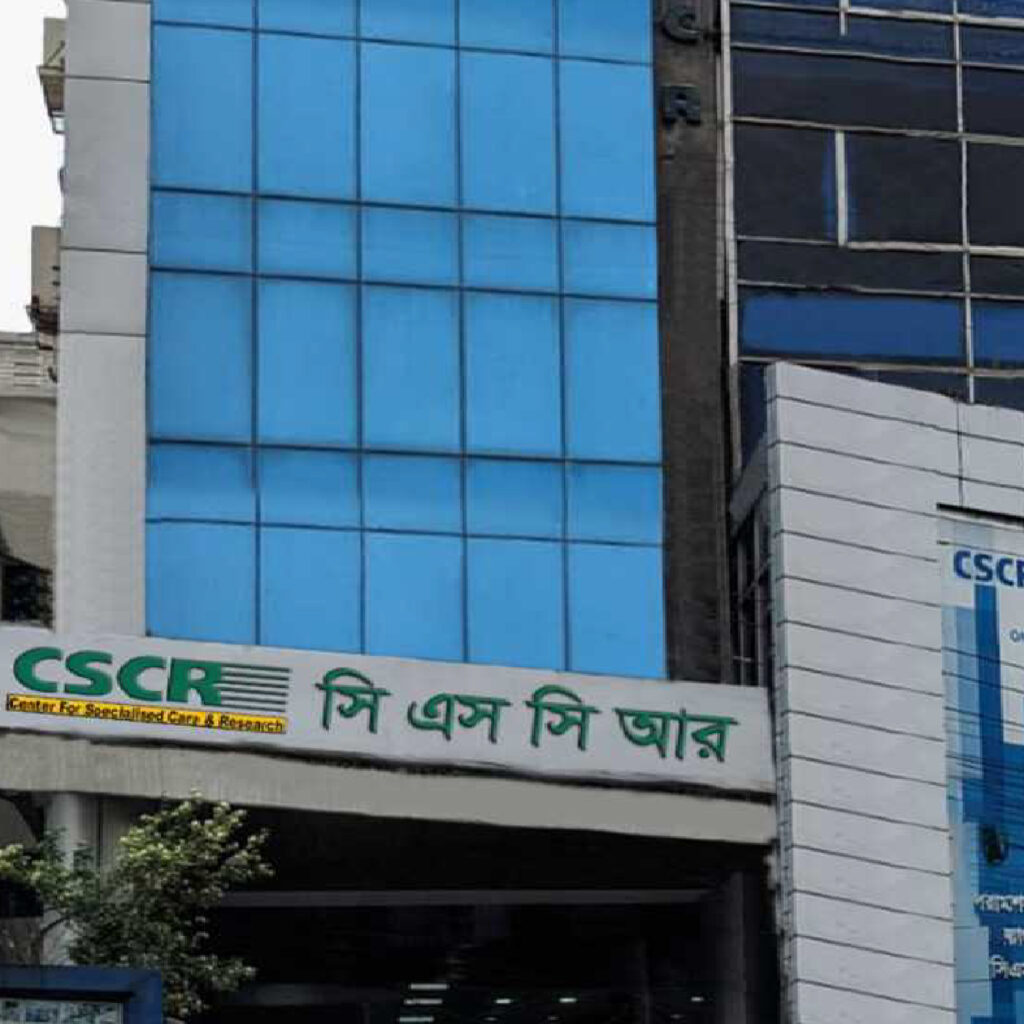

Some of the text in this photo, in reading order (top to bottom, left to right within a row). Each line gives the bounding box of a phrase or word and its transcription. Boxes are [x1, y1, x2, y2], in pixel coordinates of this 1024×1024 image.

[13, 646, 222, 707] CSCR
[9, 696, 56, 713] Center
[60, 700, 81, 714] For
[169, 710, 200, 726] Care
[220, 715, 284, 733] Research
[315, 666, 739, 763] সি এস সি আর
